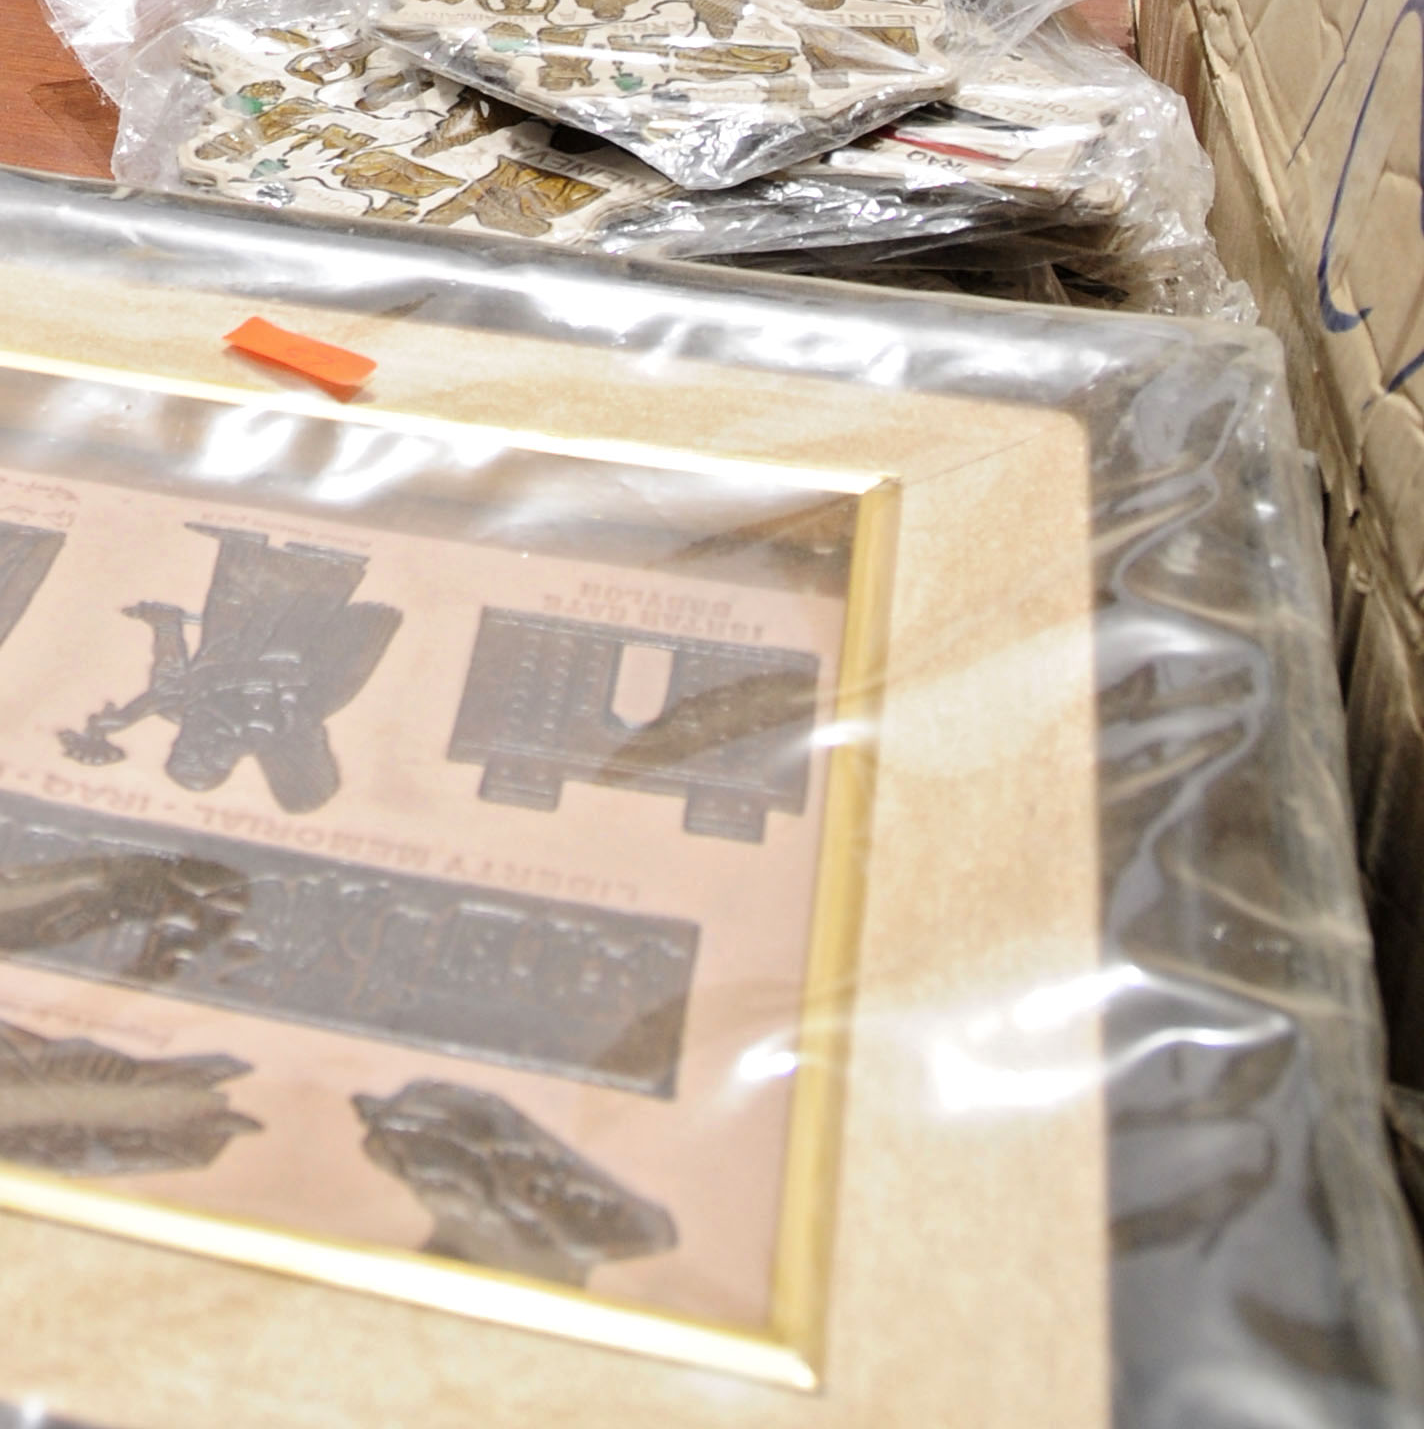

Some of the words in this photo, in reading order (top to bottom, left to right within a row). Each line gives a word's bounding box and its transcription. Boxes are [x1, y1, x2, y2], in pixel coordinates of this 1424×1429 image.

[906, 149, 969, 175] IRAQ
[25, 769, 153, 816] IRAQ
[195, 802, 433, 872] MEMORIAL
[446, 855, 641, 906] LIBERTY
